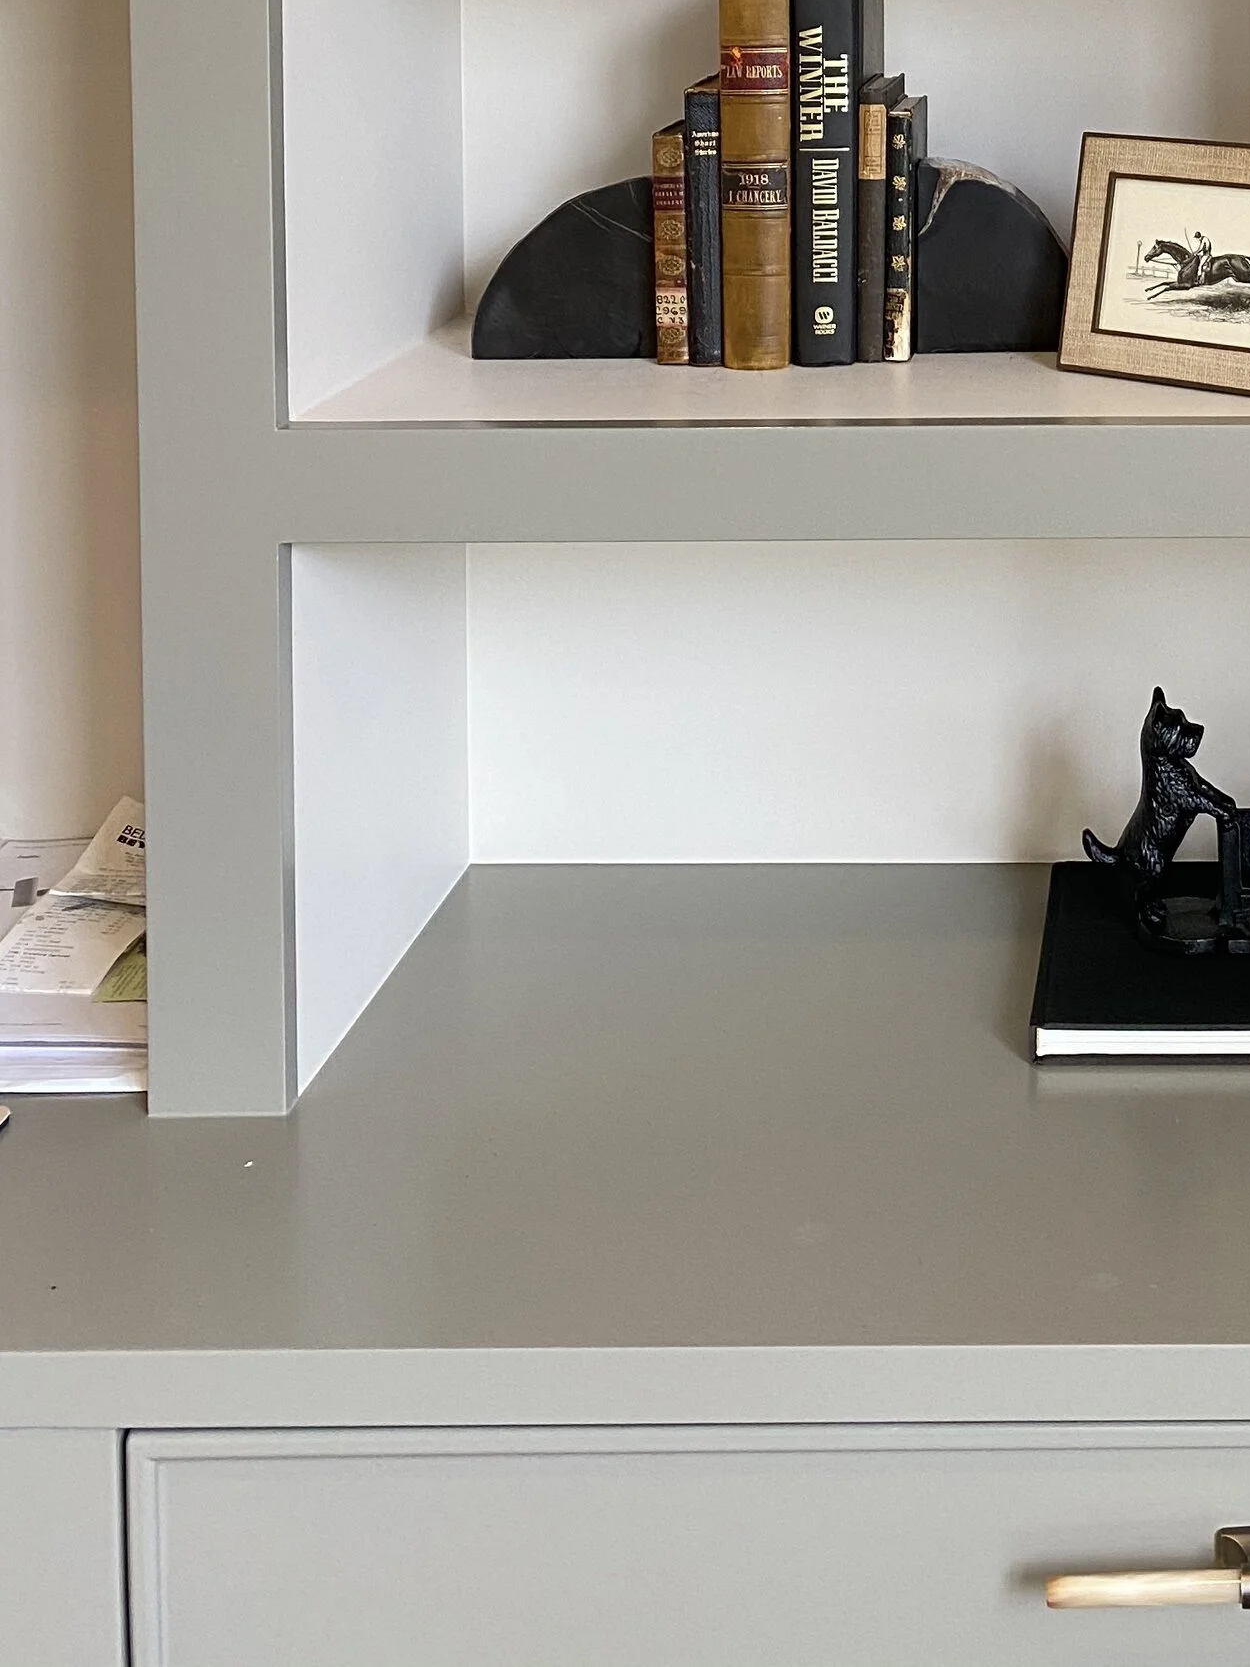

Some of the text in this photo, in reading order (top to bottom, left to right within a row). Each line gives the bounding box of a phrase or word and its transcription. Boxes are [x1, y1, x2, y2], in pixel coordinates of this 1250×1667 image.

[726, 64, 783, 79] LAW REPORTS
[799, 25, 824, 142] WINNER
[823, 53, 849, 113] THE
[812, 158, 840, 284] DAVID BALDACCI
